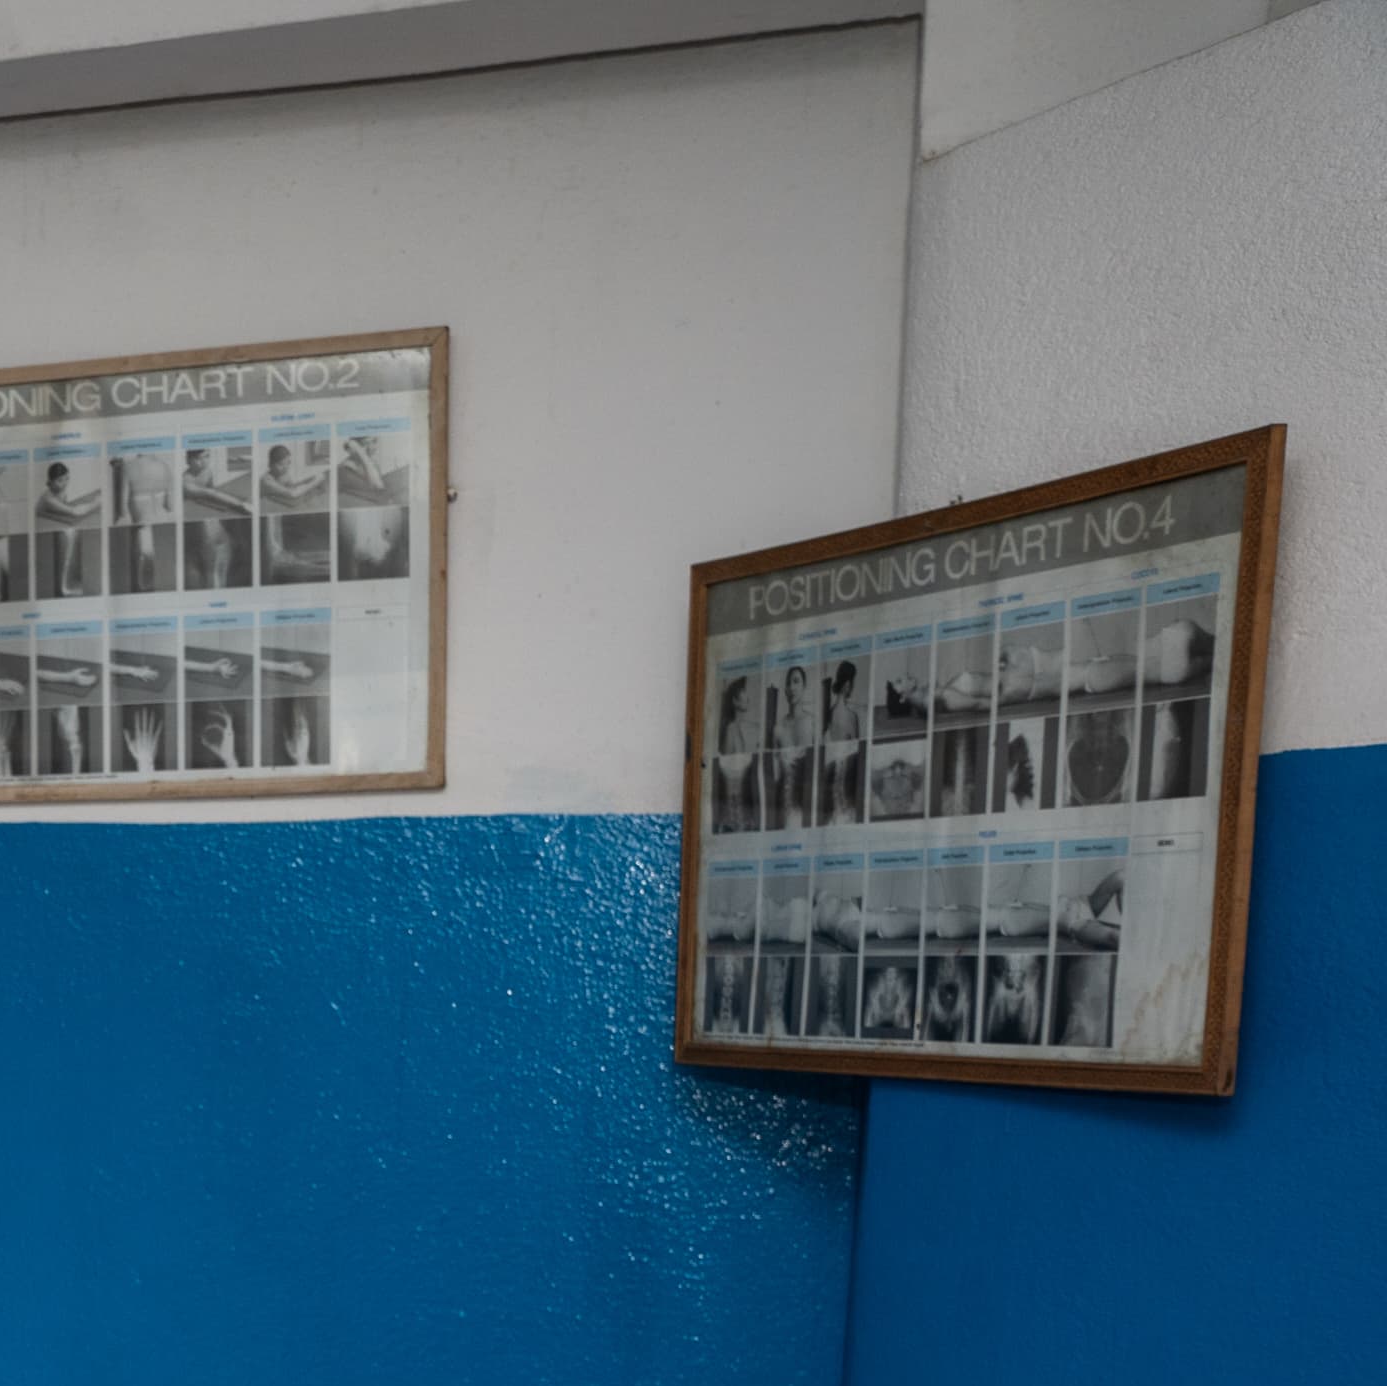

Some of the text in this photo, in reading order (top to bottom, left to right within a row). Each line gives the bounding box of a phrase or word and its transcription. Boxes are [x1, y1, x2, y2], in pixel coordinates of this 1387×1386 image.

[111, 365, 258, 408] CHART
[266, 359, 360, 397] NO.2
[748, 548, 935, 620] POSITIONING
[944, 517, 1072, 580] CHART
[1081, 495, 1176, 553] NO.4
